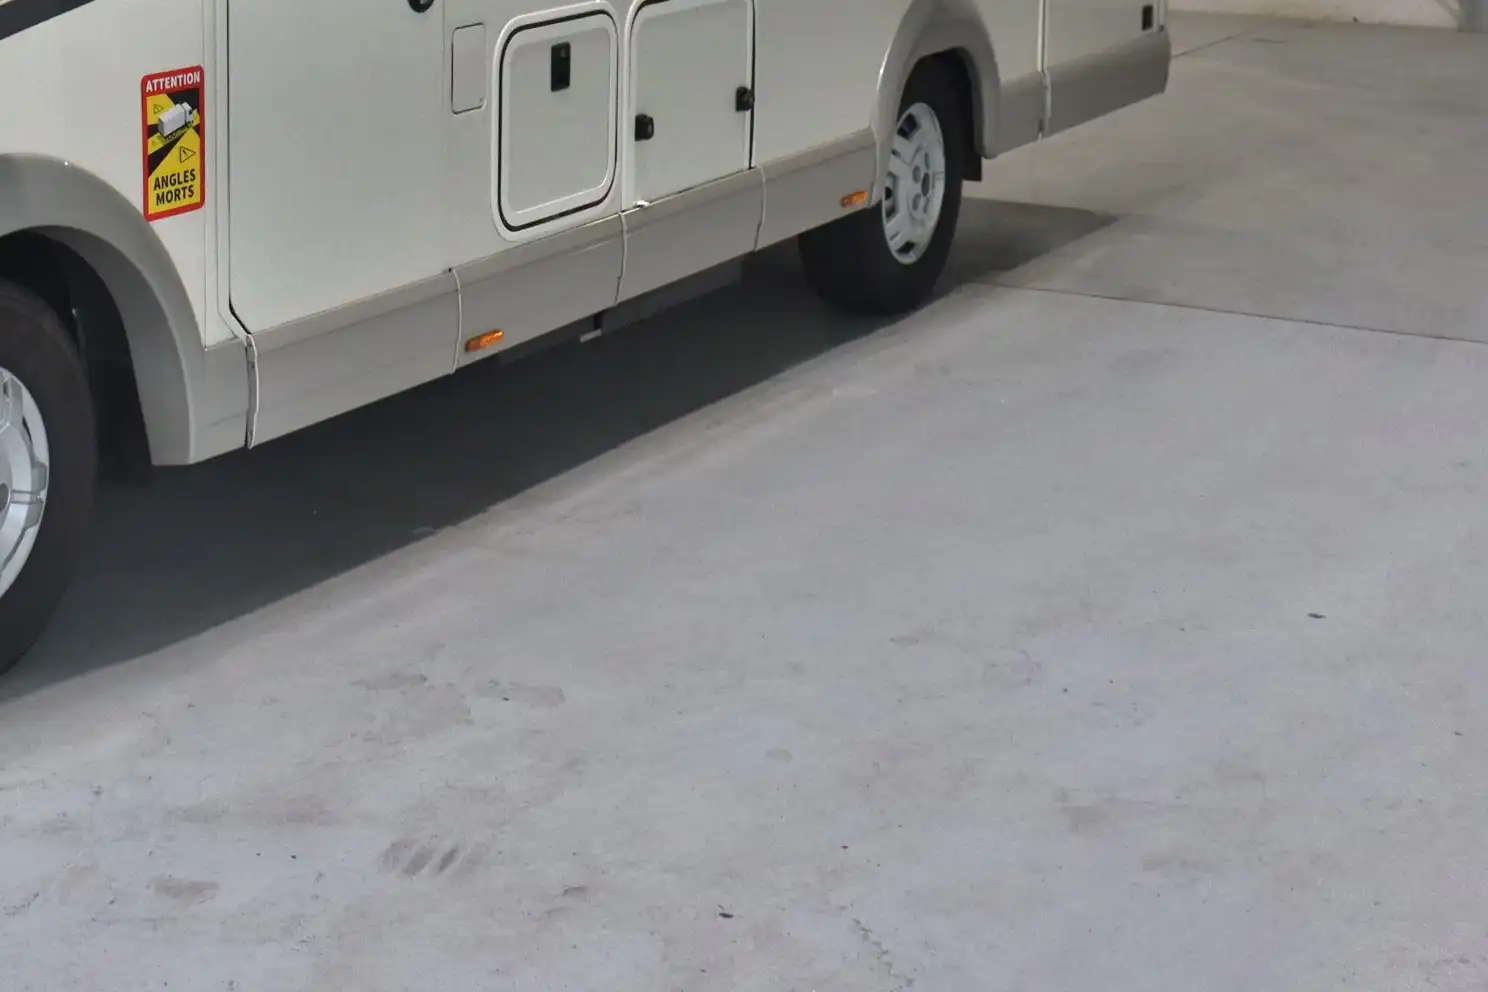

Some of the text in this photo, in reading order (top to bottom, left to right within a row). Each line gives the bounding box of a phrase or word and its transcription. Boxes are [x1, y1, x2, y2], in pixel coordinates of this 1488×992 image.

[145, 71, 201, 93] ATTENTION
[153, 168, 196, 191] ANGLES
[156, 184, 195, 206] MORTS
